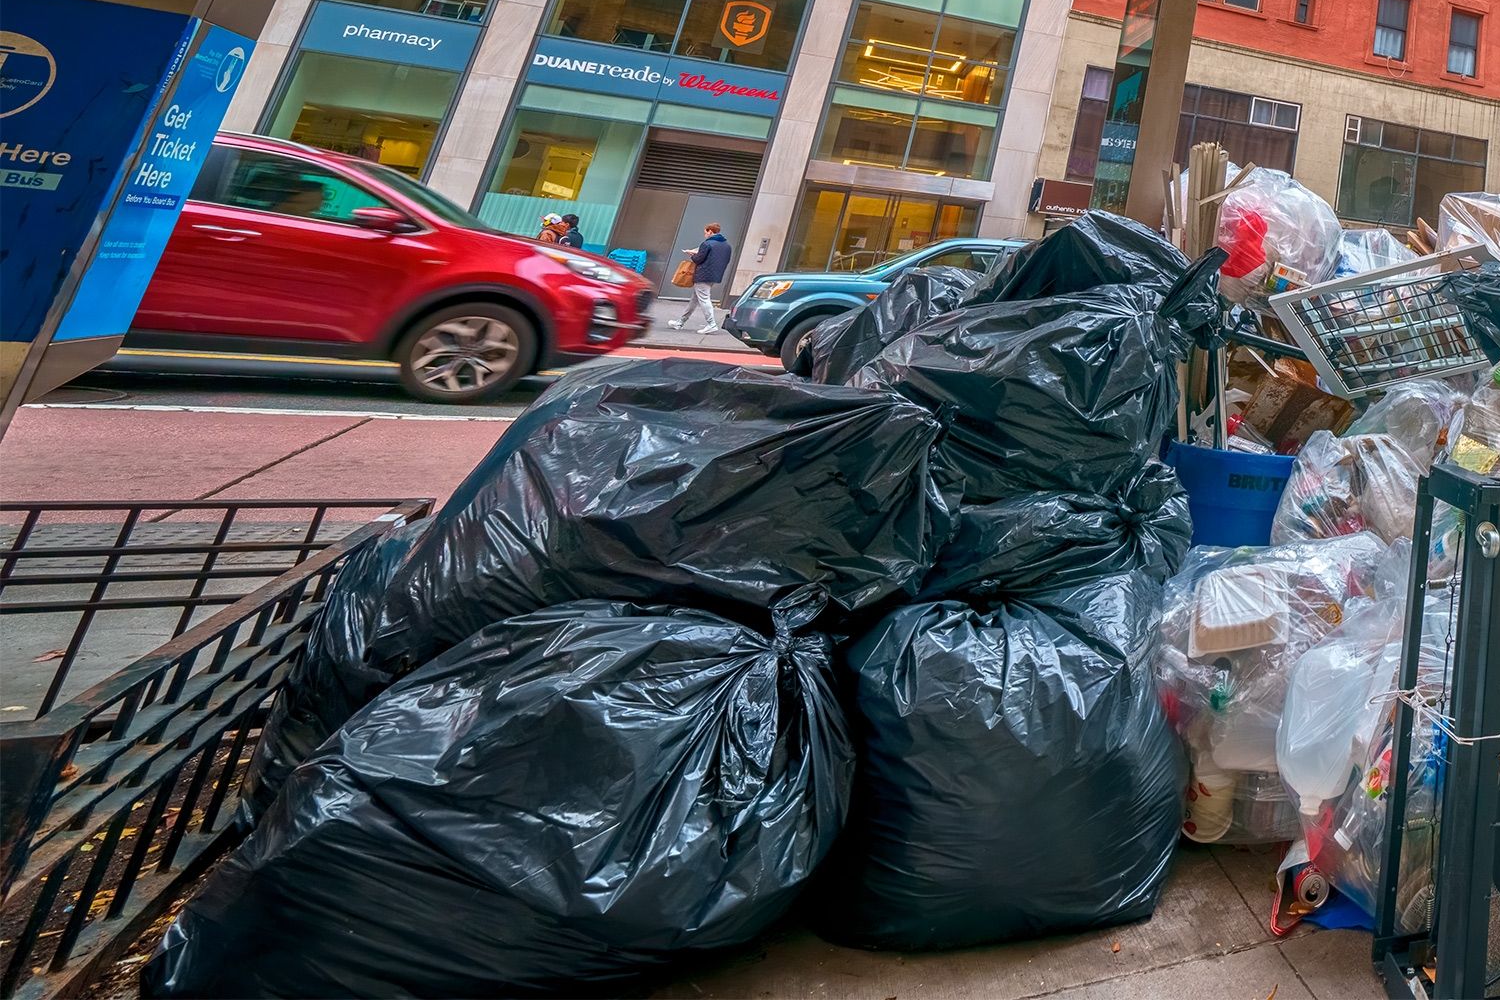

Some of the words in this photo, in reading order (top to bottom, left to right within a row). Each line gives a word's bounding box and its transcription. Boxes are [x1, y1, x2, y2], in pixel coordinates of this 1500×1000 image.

[343, 24, 442, 51] pharmacy
[662, 76, 675, 87] by
[678, 72, 780, 101] Walgreens
[164, 104, 192, 130] Get
[150, 133, 196, 162] Ticket
[4, 172, 45, 187] Bus
[134, 162, 172, 188] Here
[125, 193, 143, 204] Before
[143, 195, 151, 205] You
[152, 196, 166, 205] Board
[166, 198, 176, 207] Bus
[1228, 473, 1284, 492] BRUT
